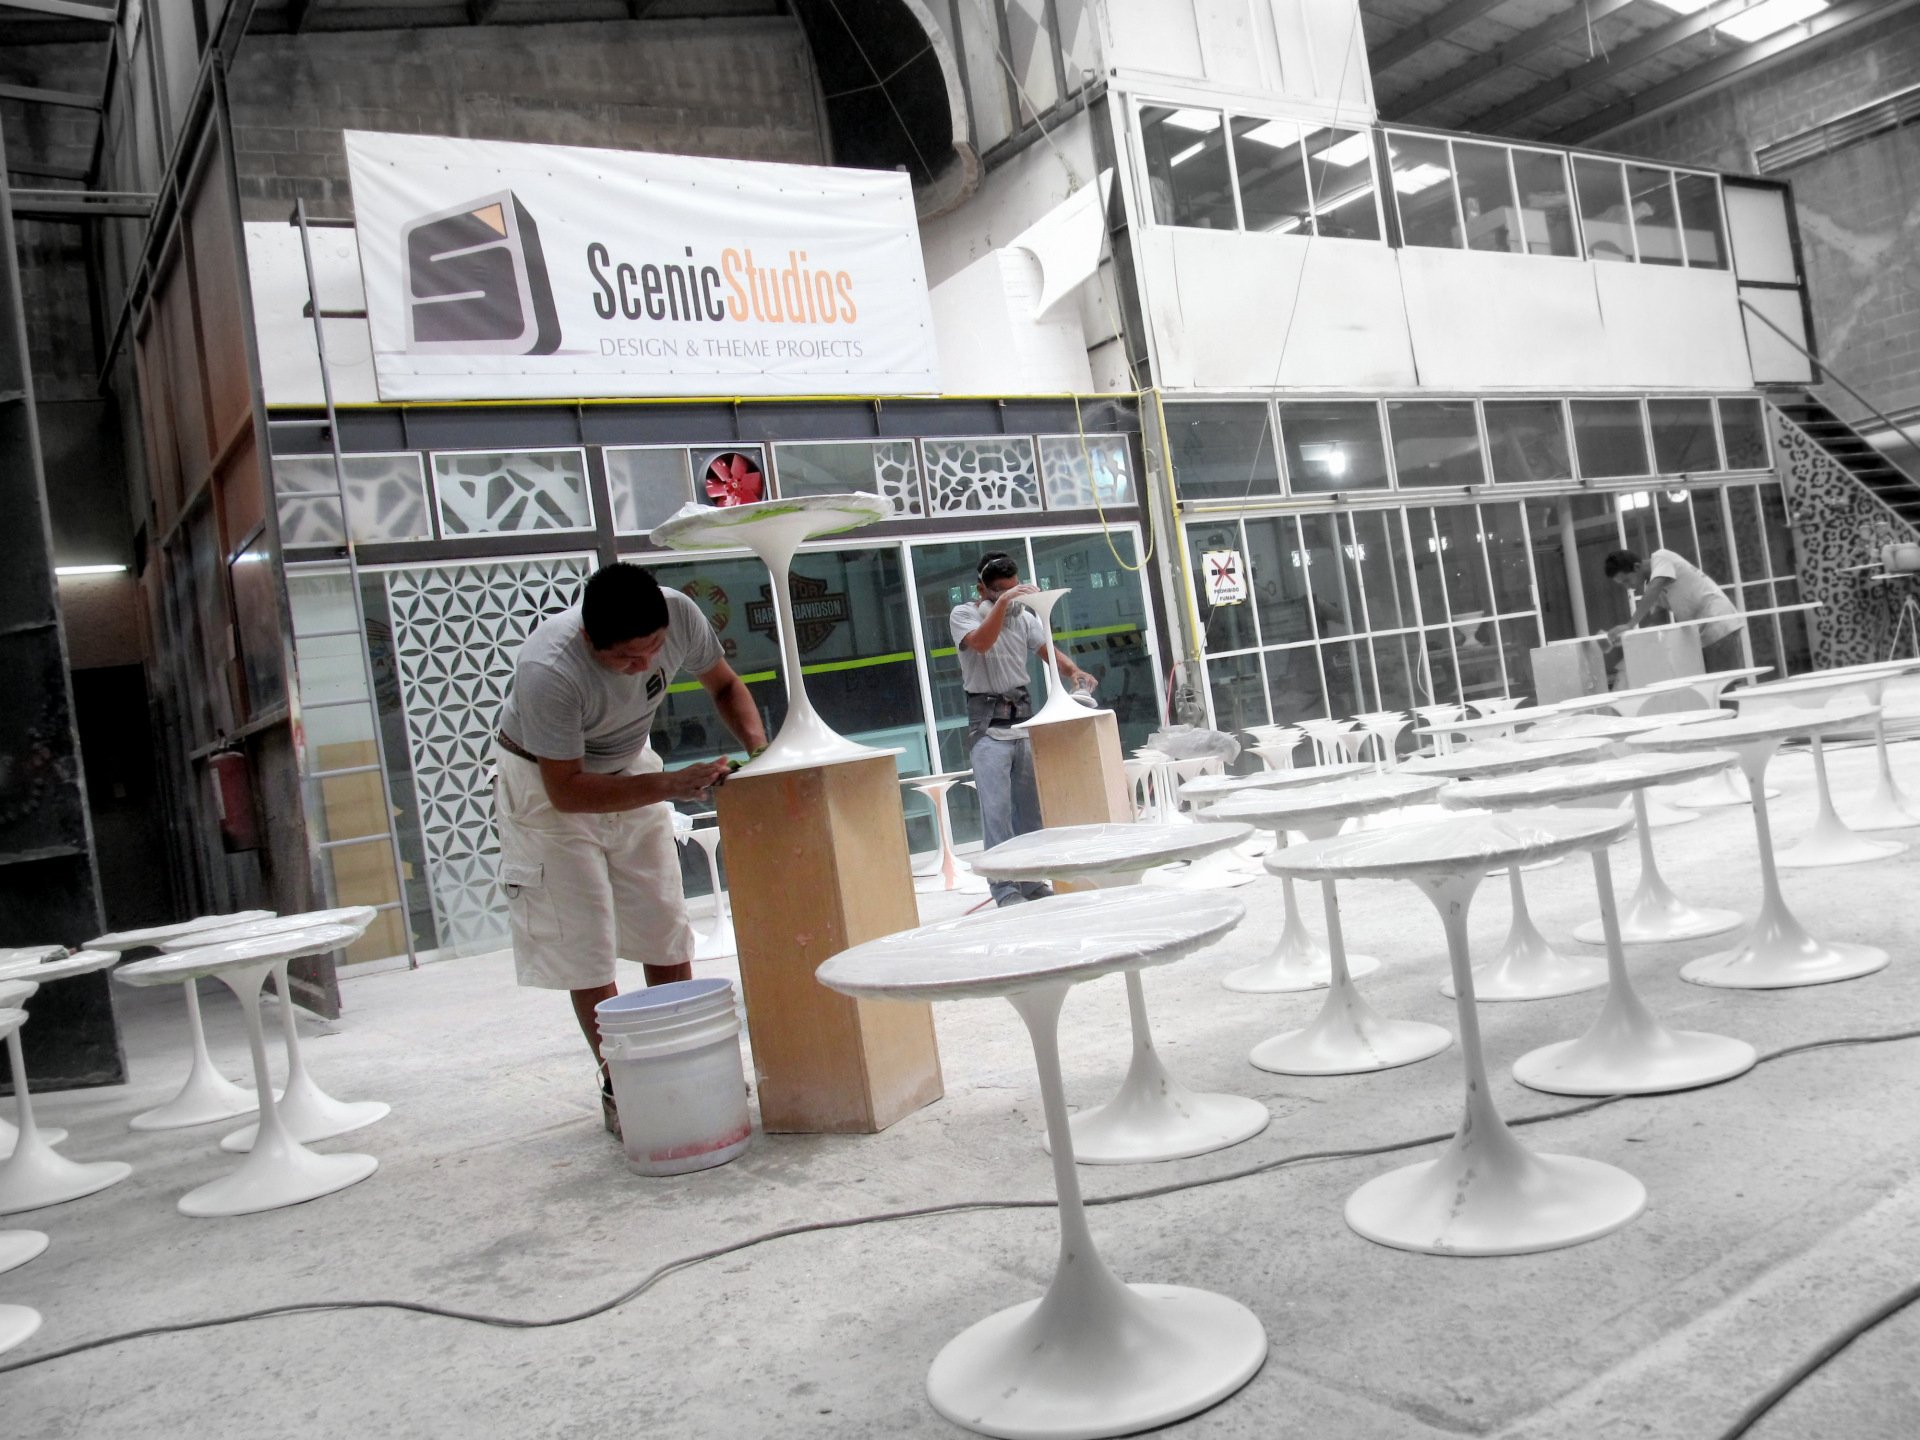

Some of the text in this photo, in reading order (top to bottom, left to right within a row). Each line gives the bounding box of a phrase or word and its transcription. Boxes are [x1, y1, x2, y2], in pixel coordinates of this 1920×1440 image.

[587, 242, 857, 324] ScenicStudios
[600, 338, 863, 360] DESIGN & THEME PROJECTS
